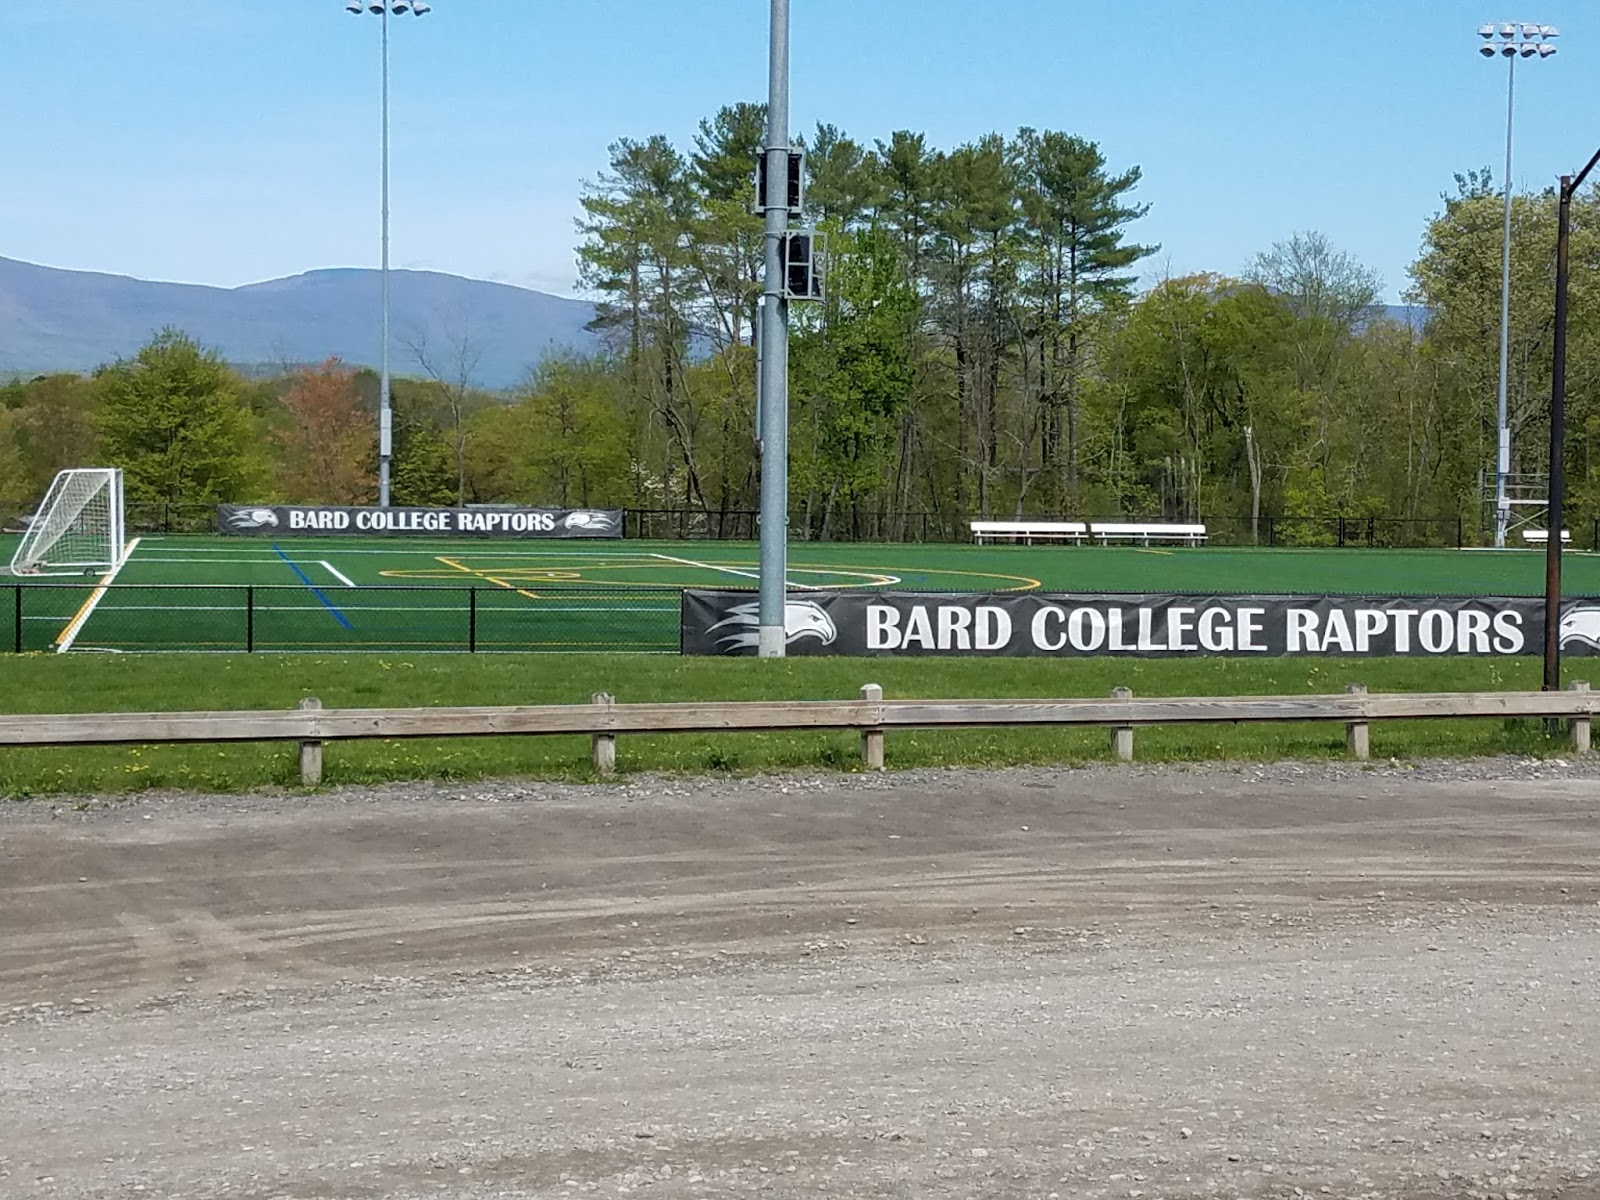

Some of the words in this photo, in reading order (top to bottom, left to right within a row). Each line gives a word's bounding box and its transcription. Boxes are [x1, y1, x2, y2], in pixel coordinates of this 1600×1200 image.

[289, 510, 349, 529] BARD
[356, 510, 451, 530] COLLEGE
[458, 512, 555, 531] RAPTORS
[865, 605, 1012, 650] BARD
[1031, 605, 1268, 652] COLLEGE
[1286, 608, 1526, 655] RAPTORS
